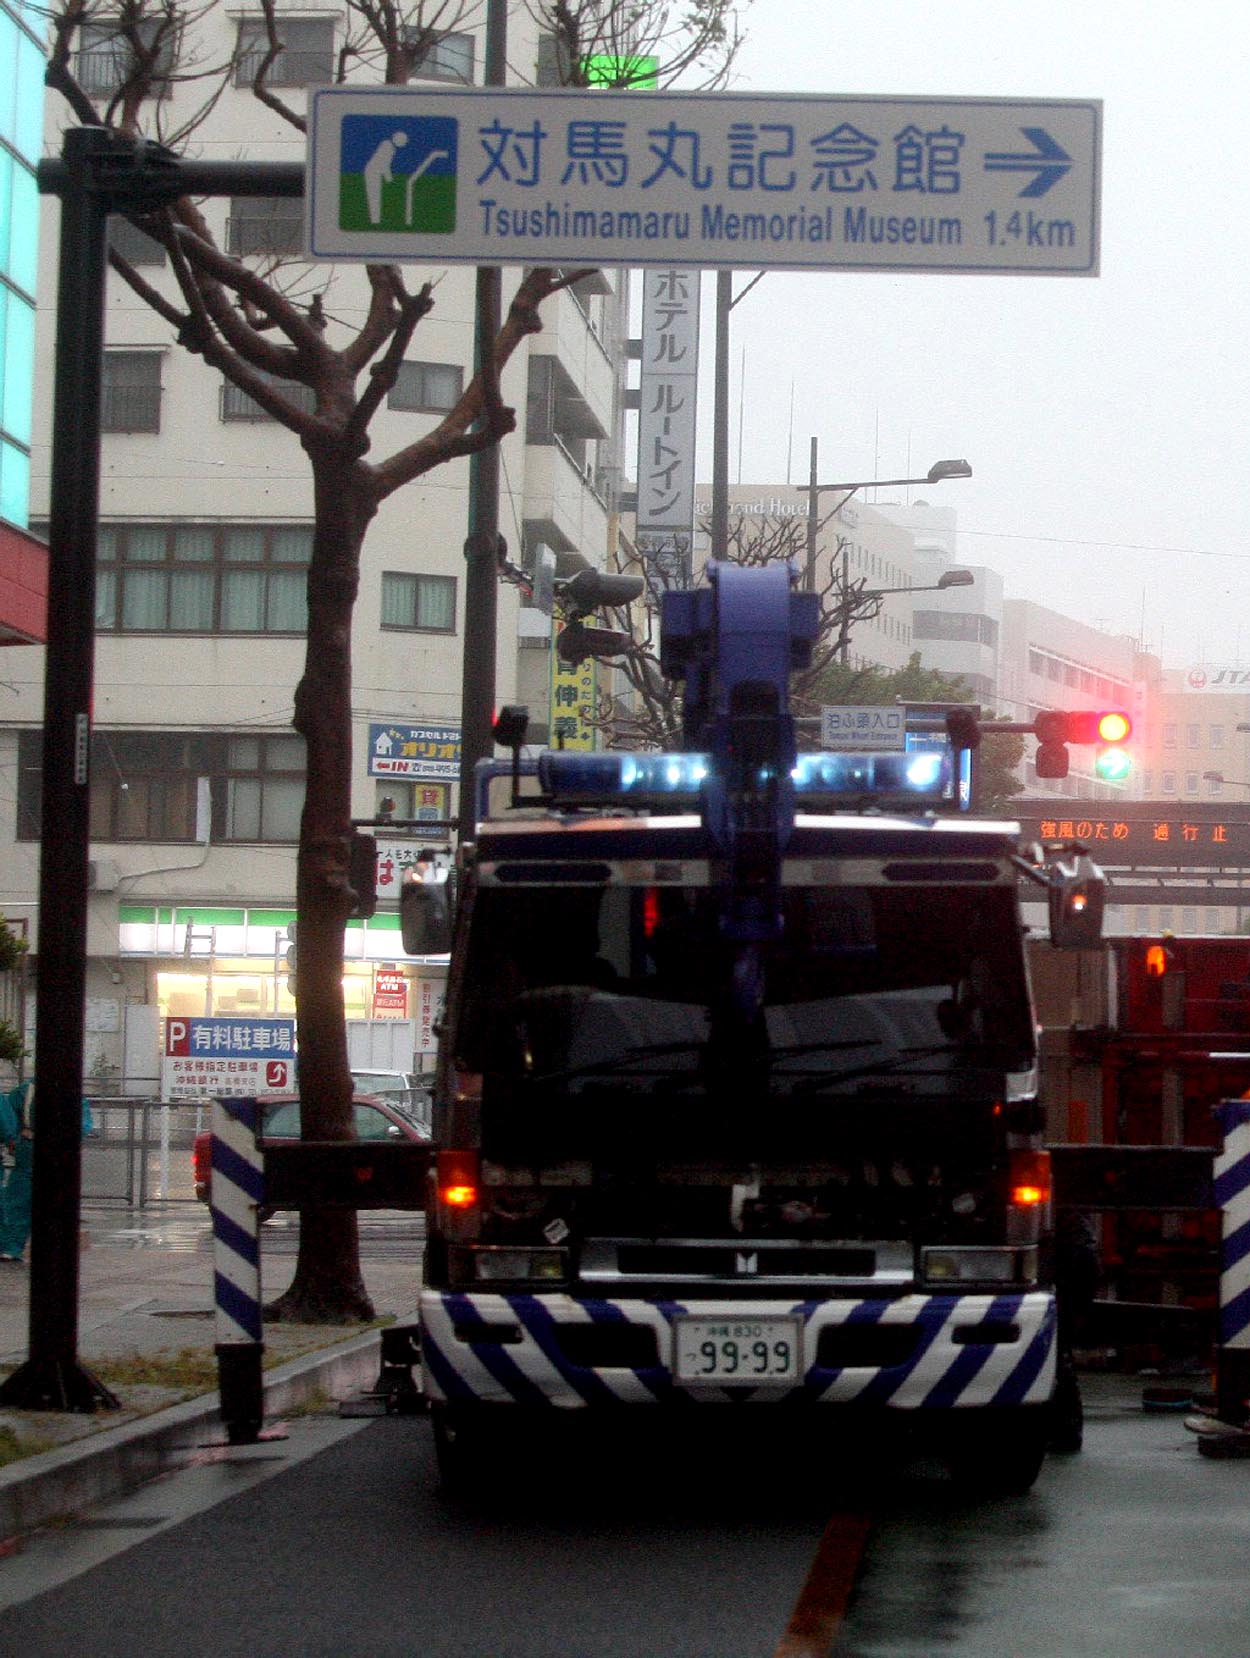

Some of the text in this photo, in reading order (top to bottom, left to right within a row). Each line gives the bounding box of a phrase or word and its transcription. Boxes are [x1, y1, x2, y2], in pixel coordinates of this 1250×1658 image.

[476, 119, 966, 195] 対馬丸記念館
[480, 200, 1076, 249] Tsushimamaru Memorial Museum 1.4km
[654, 270, 689, 363] ホテル
[649, 384, 684, 516] ルートイン
[771, 497, 811, 516] Hotel
[391, 762, 410, 773] IN
[1041, 820, 1130, 840] 強風のため
[380, 982, 399, 991] ATM
[169, 1021, 291, 1052] P 有料駐車場
